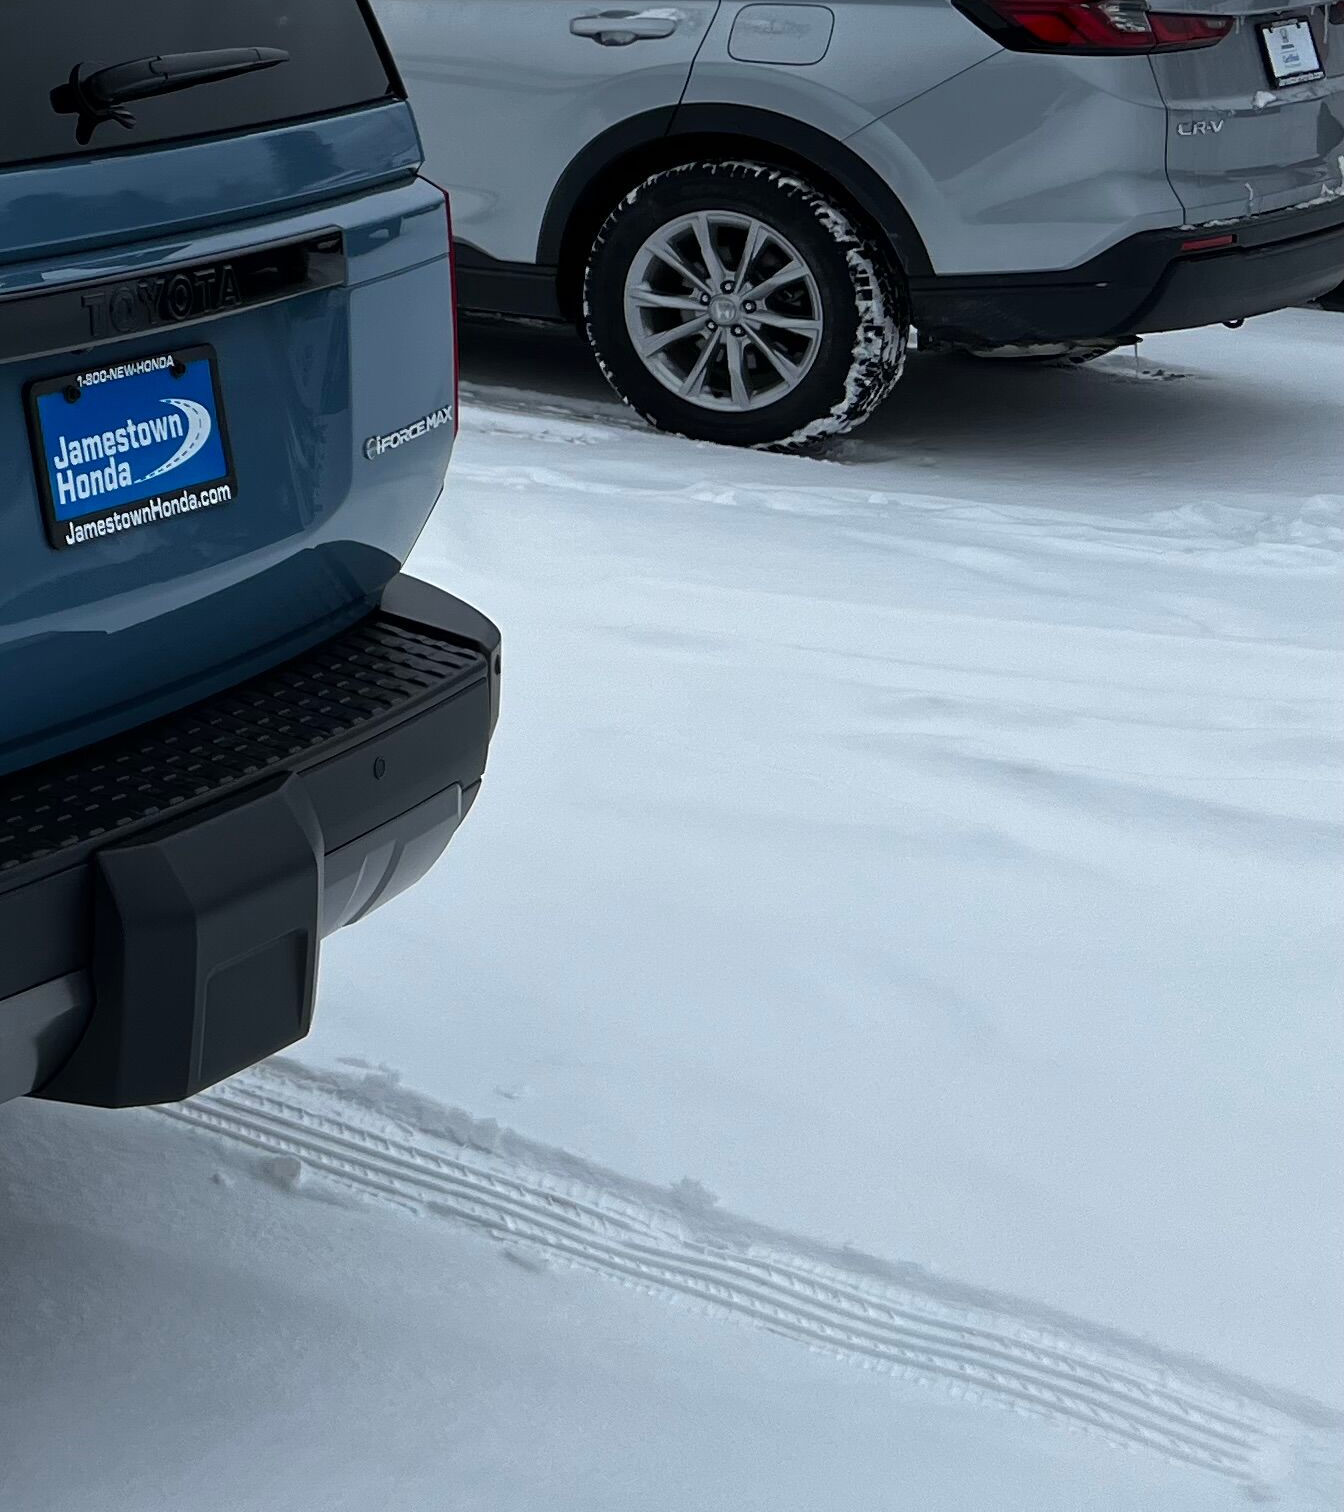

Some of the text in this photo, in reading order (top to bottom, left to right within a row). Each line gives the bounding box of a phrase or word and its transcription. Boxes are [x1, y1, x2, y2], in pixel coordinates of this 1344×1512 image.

[1177, 119, 1224, 136] CR-V
[80, 264, 242, 338] TOYOTA
[76, 355, 175, 388] 1-800-NEW-HONDA
[53, 413, 184, 470] Jamestown
[425, 405, 453, 432] MAX
[56, 456, 133, 505] Honda
[65, 484, 232, 546] JamestownHonda.com
